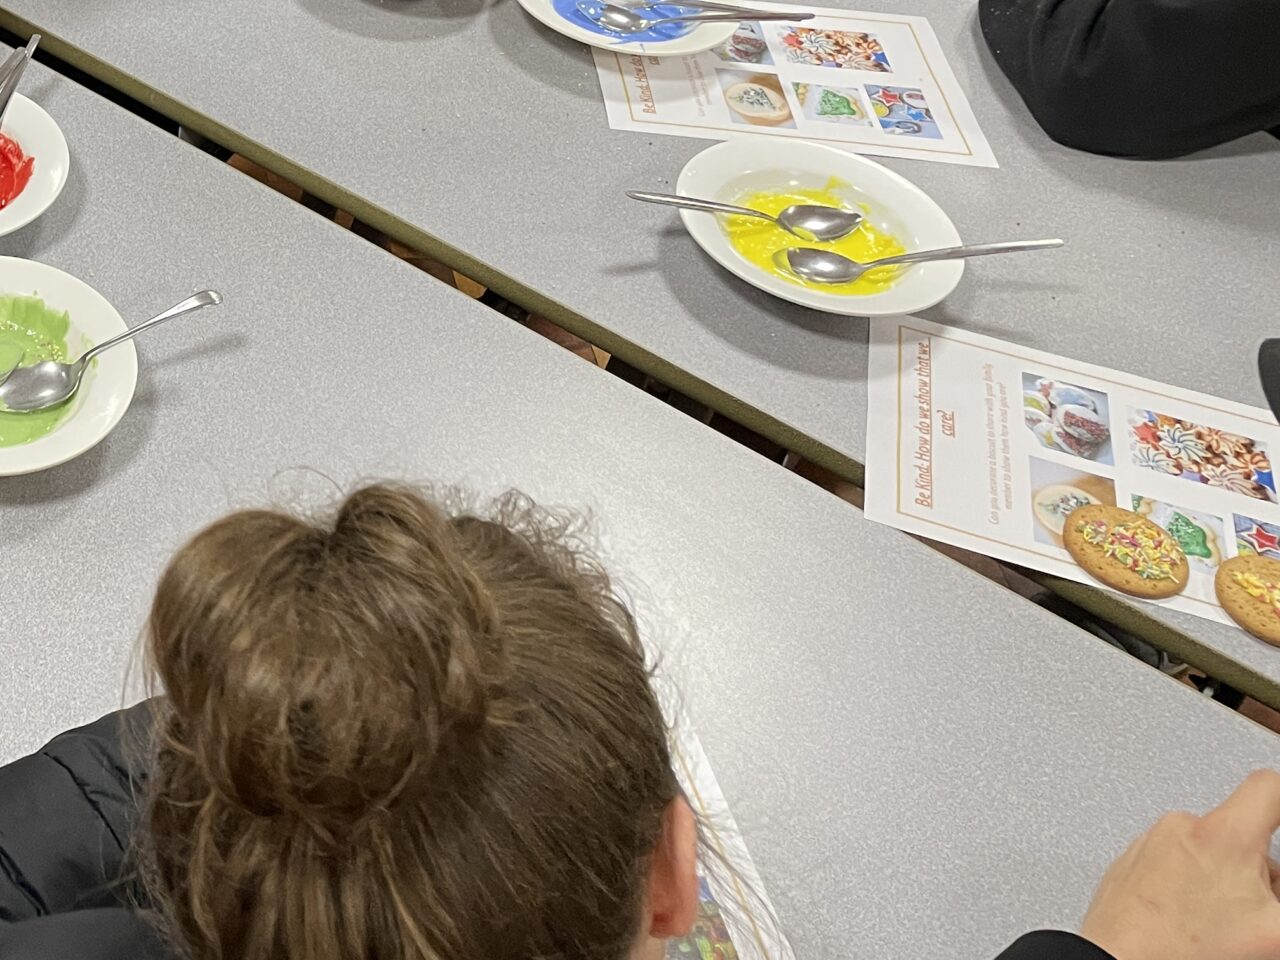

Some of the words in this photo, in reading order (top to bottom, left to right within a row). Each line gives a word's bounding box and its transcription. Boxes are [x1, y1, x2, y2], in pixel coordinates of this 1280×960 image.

[630, 58, 642, 67] do
[634, 68, 646, 82] How
[643, 104, 654, 113] Be
[918, 342, 929, 355] we
[914, 356, 929, 377] that
[914, 379, 929, 404] show
[920, 407, 929, 419] we
[914, 422, 930, 434] do
[936, 410, 953, 437] care?
[916, 437, 930, 462] How
[914, 463, 930, 491] Kind:
[914, 492, 930, 507] Be
